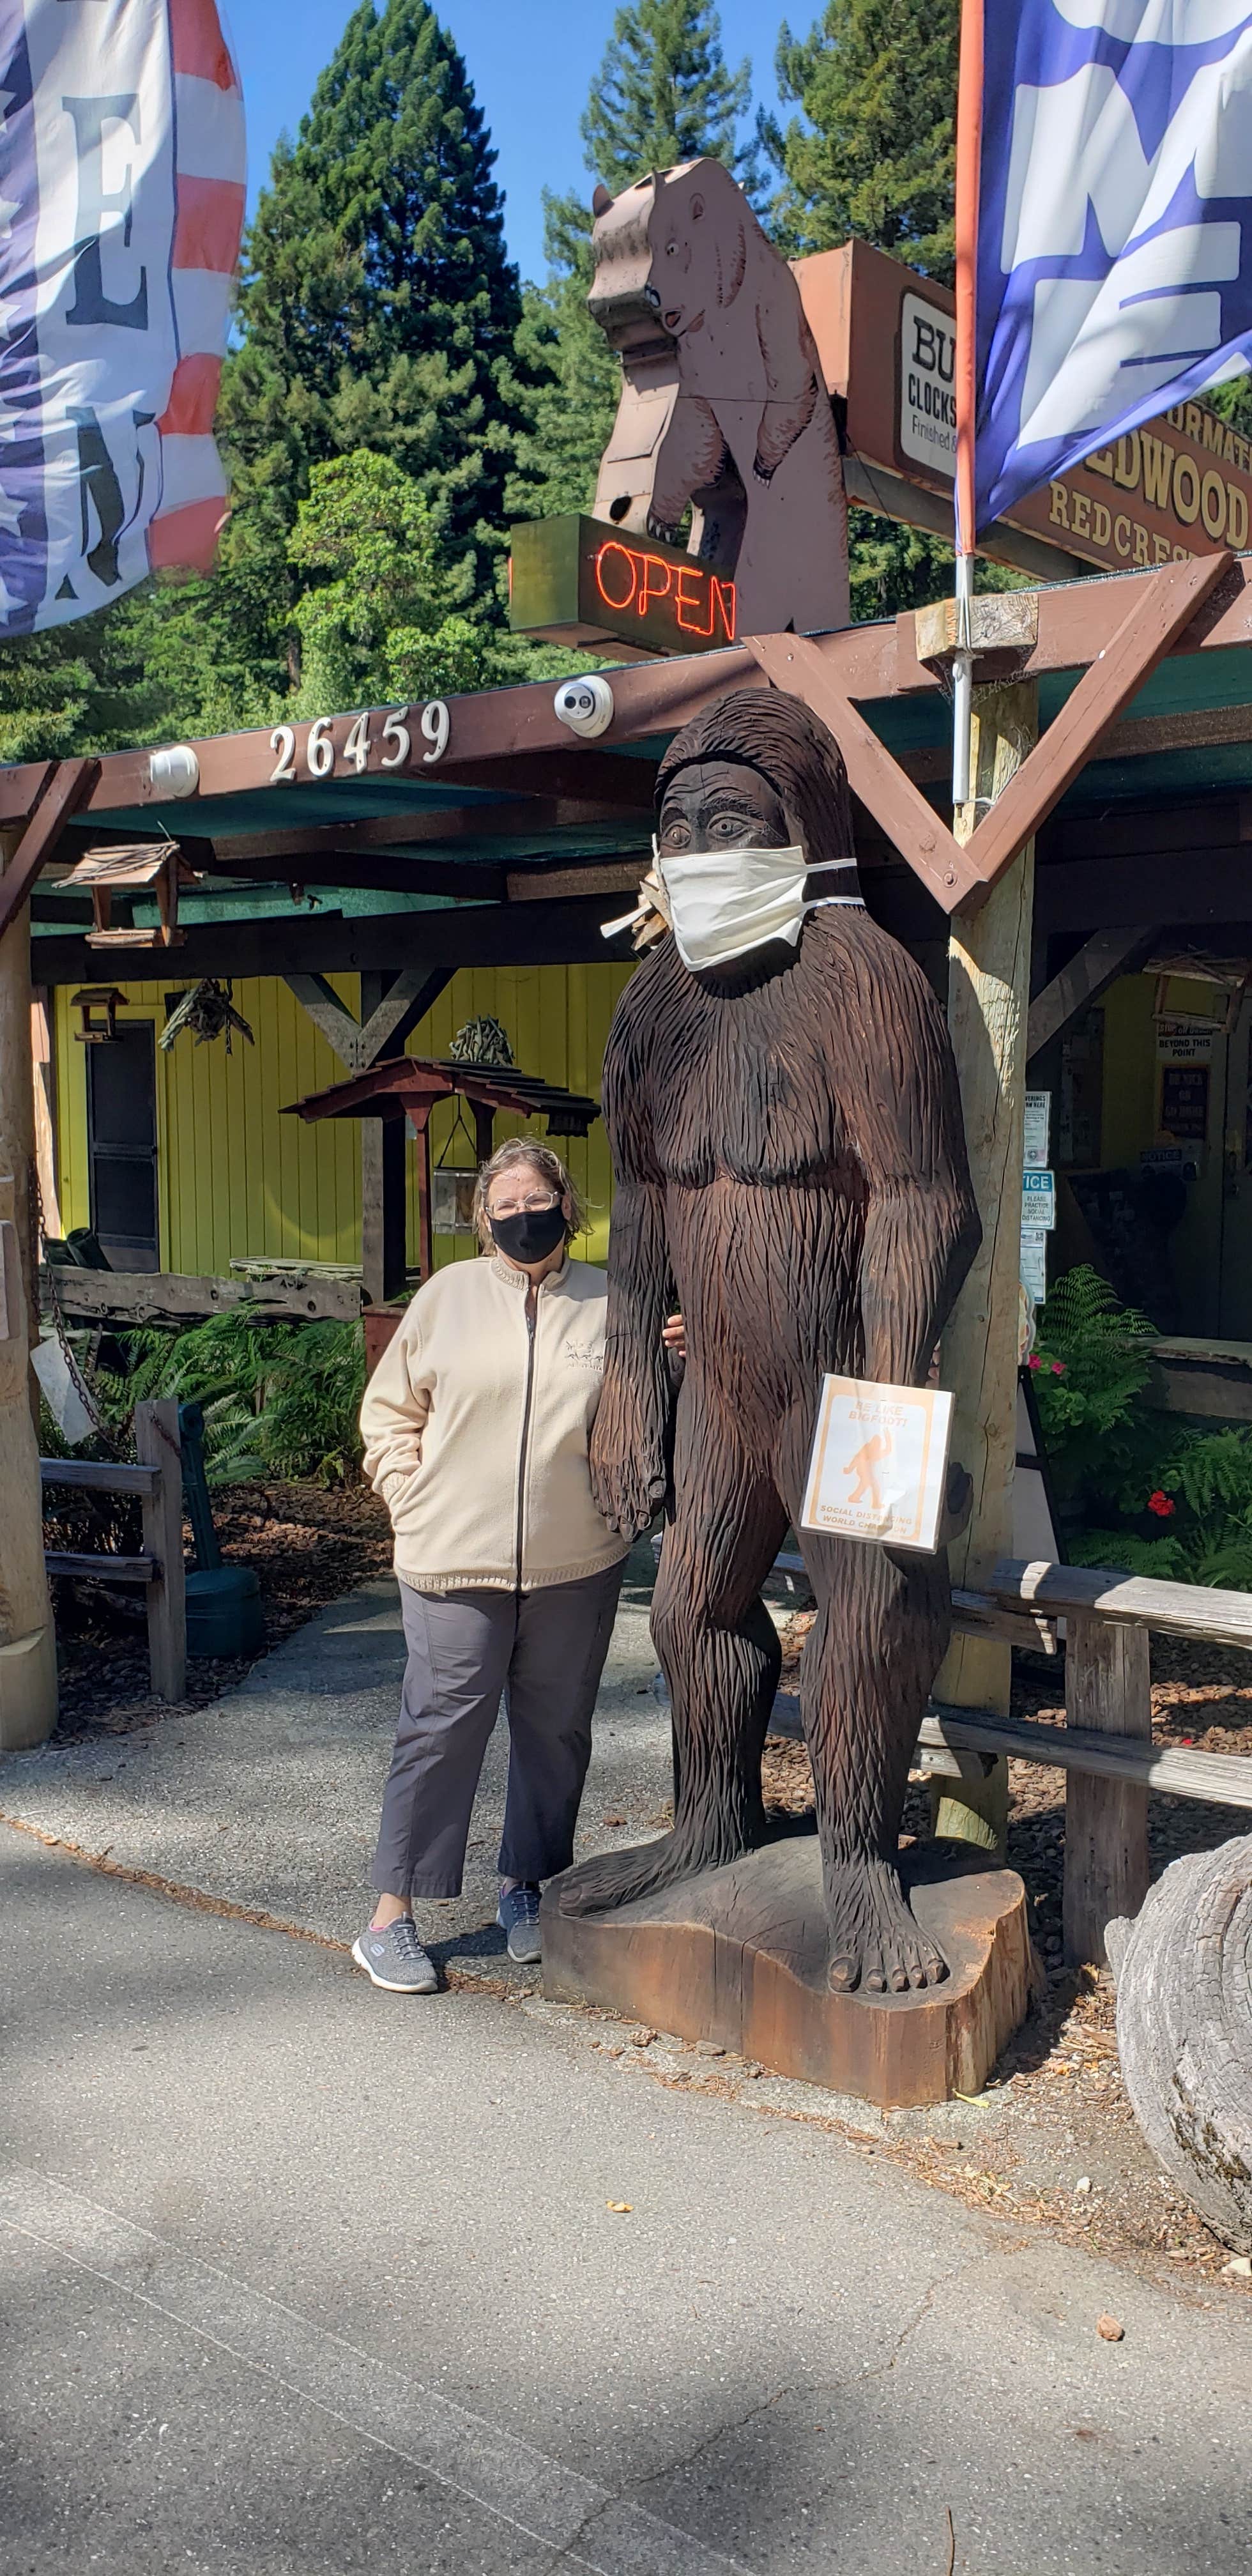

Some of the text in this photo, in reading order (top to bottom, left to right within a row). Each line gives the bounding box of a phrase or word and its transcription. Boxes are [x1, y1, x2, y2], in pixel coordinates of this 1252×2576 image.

[908, 372, 956, 428] CLOCKS
[912, 414, 950, 451] Finished
[1167, 399, 1252, 475] ORMAT
[1050, 480, 1201, 566] REDCRE
[597, 540, 736, 640] OPEN
[270, 700, 450, 783] 26459
[1159, 1038, 1211, 1048] BEYOND THIS
[1172, 1048, 1196, 1057] POINT
[848, 1411, 908, 1427] BIGFOOT!
[856, 1400, 904, 1415] BE LIKE
[820, 1505, 853, 1517] SOCIAL
[823, 1515, 855, 1526] WORLD
